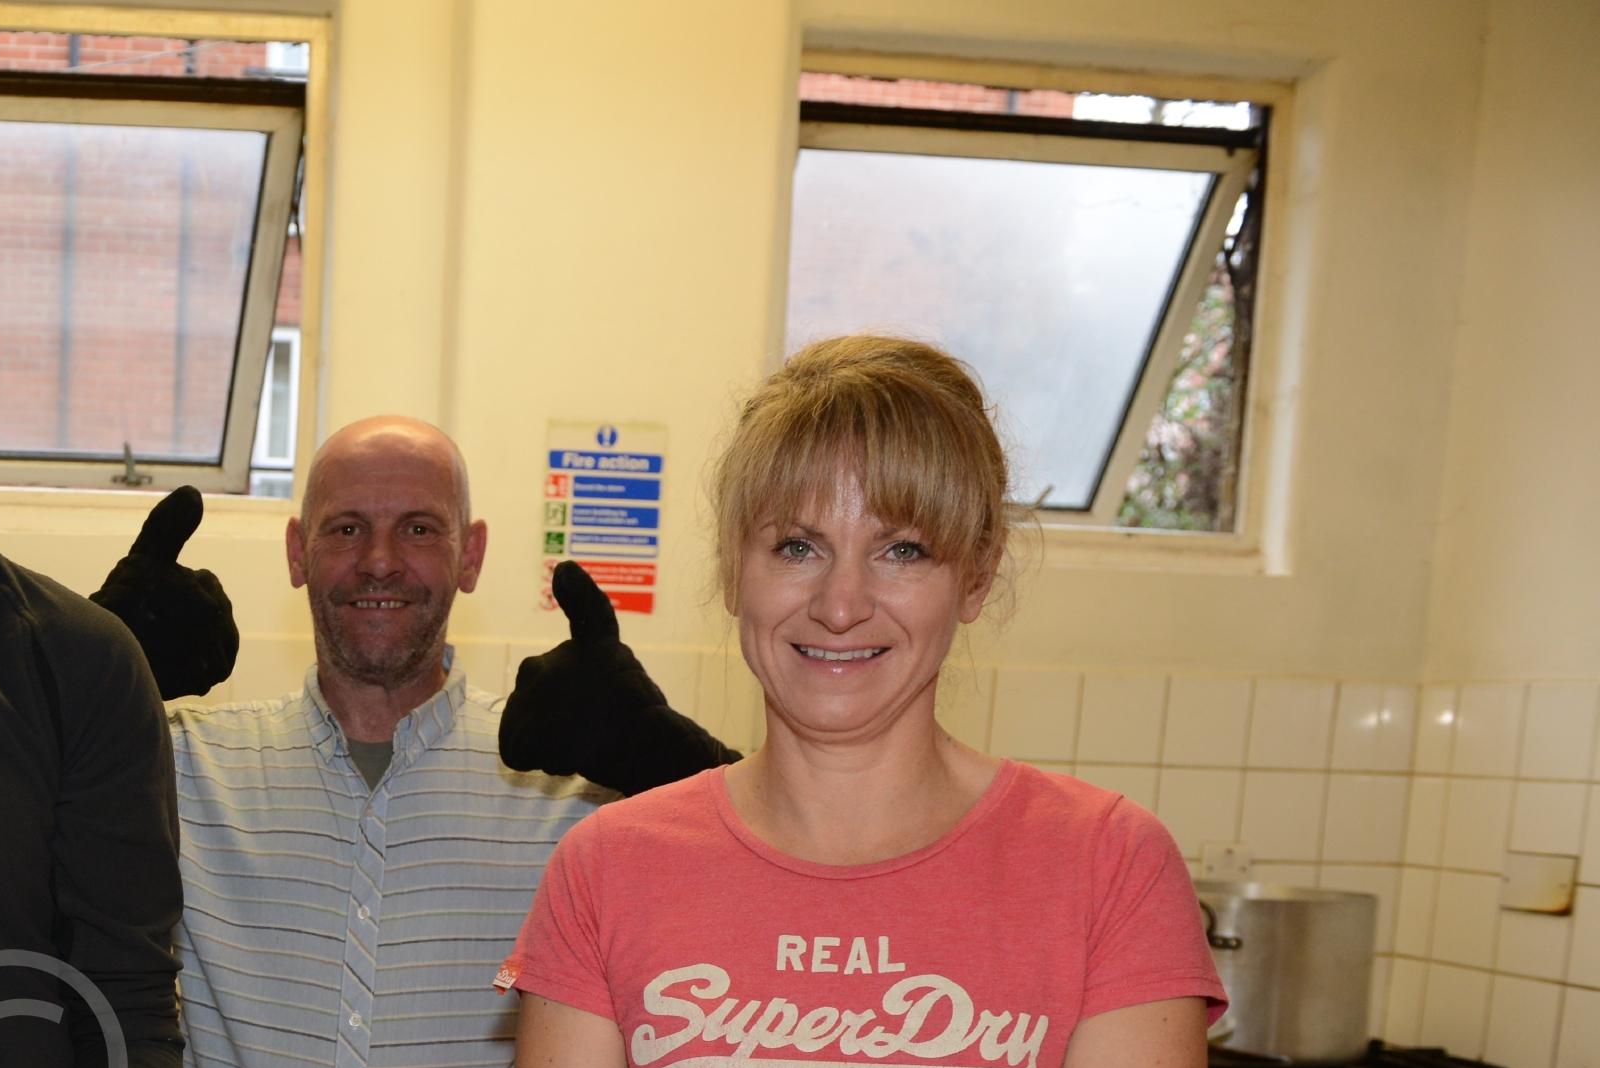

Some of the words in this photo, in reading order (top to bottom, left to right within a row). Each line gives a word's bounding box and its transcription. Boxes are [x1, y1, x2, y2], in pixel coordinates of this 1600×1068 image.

[562, 452, 595, 469] Fire
[598, 455, 649, 471] action
[776, 934, 906, 974] REAL
